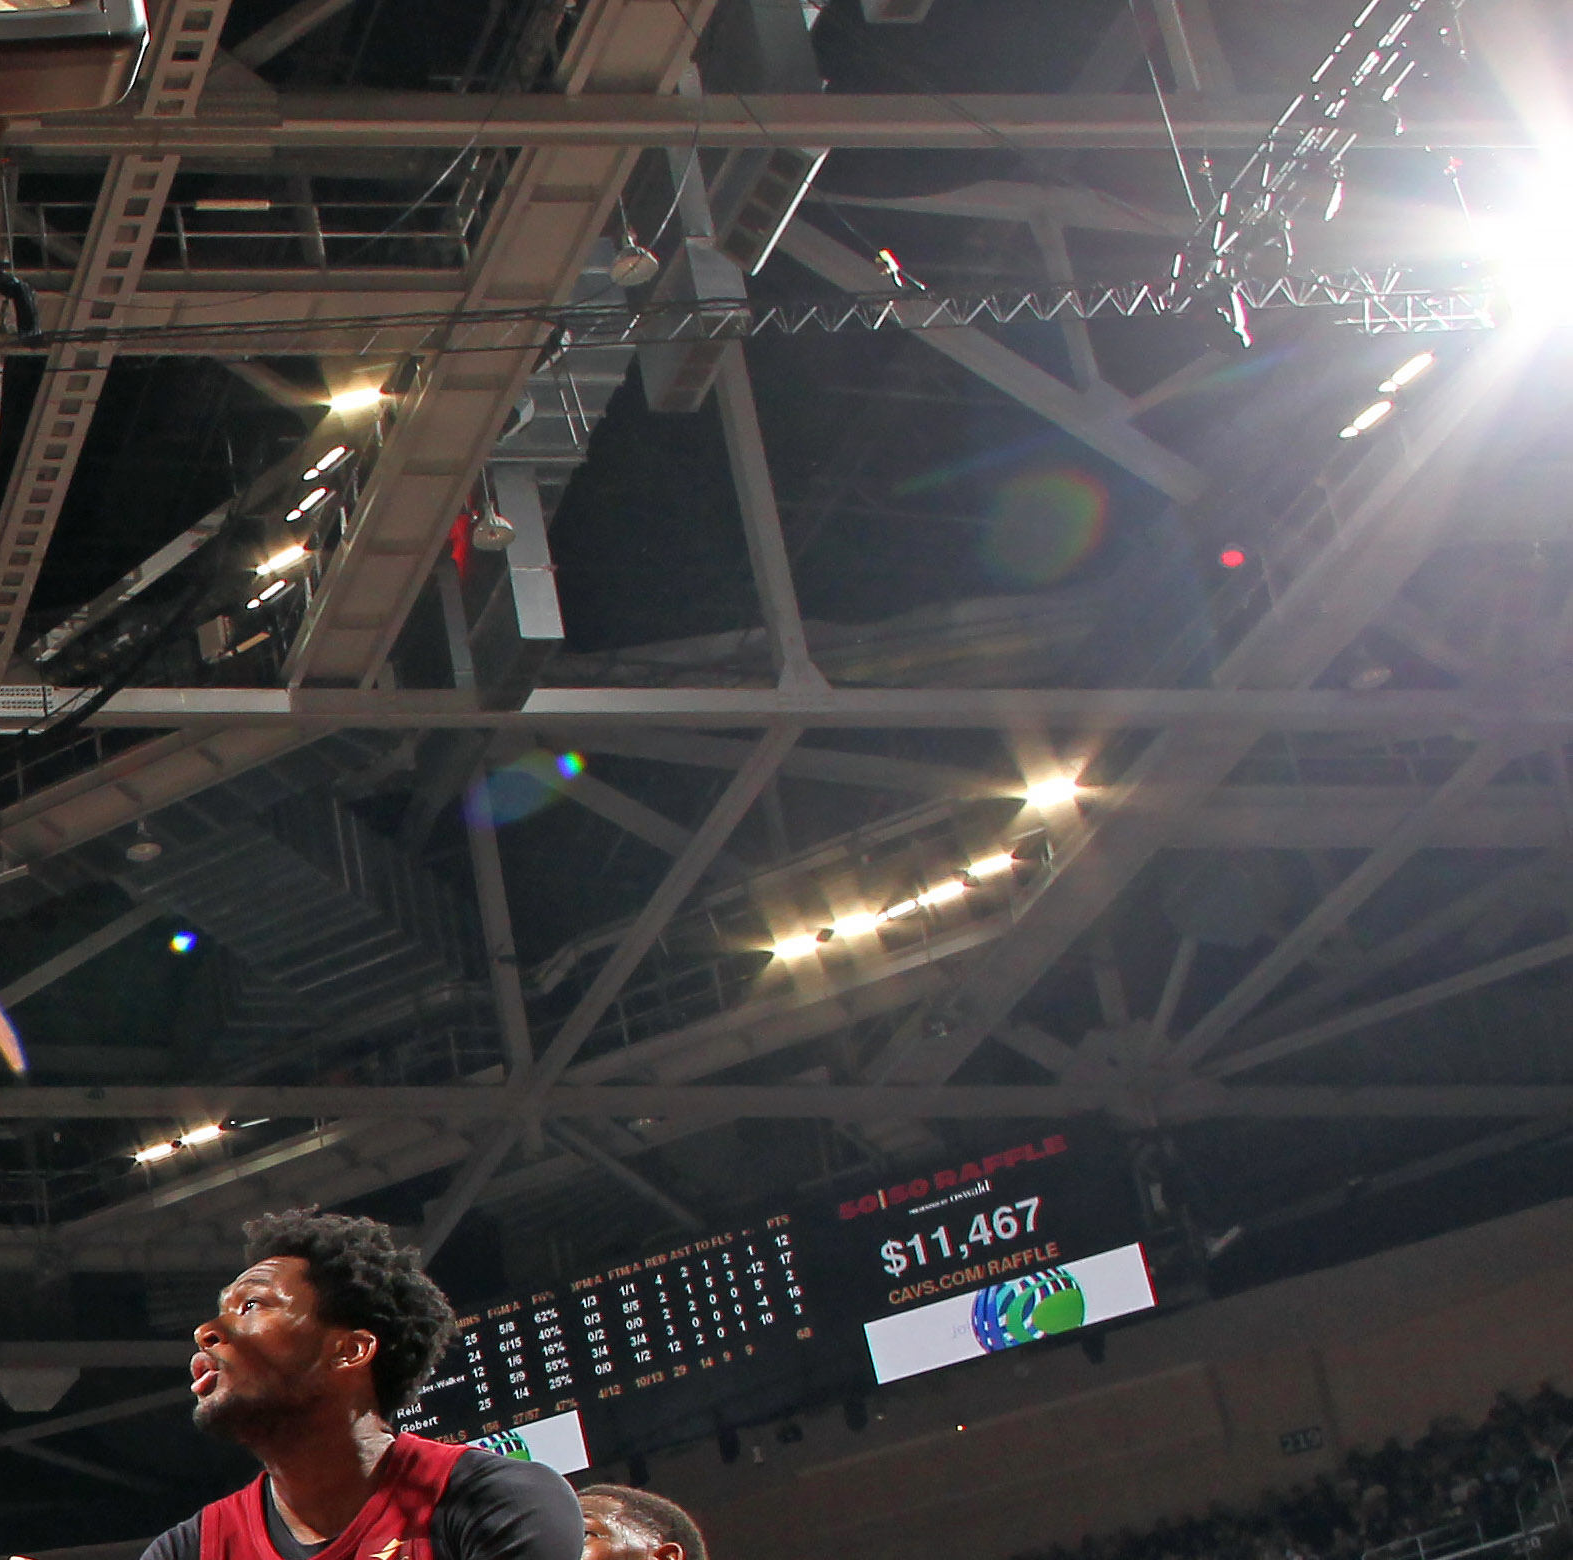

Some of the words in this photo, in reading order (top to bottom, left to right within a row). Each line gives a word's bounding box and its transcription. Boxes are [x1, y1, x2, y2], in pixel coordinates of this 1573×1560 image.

[465, 1333, 477, 1346] 25
[499, 1322, 515, 1334] 5/8
[535, 1309, 557, 1323] 62%
[582, 1296, 596, 1308] 1/3
[620, 1284, 634, 1296] 1/1
[655, 1275, 662, 1284] 4
[681, 1267, 688, 1277] 2
[703, 1260, 708, 1269] 1
[723, 1254, 730, 1264] 2
[748, 1246, 753, 1255] 1
[775, 1235, 788, 1246] 12
[880, 1196, 1042, 1277] $11,467
[889, 1242, 1061, 1305] CAVS.COM/RAFFLE
[397, 1403, 421, 1418] Reid
[476, 1382, 488, 1393] 16
[510, 1371, 525, 1383] 5/9
[546, 1358, 568, 1372] 55%
[592, 1345, 608, 1358] 3/4
[630, 1334, 648, 1346] 3/4
[667, 1325, 673, 1335] 3
[692, 1318, 699, 1327] 0
[714, 1311, 720, 1320] 0
[735, 1304, 741, 1314] 0
[788, 1286, 800, 1298] 16
[468, 1351, 481, 1362] 24
[500, 1337, 521, 1352] 6/15
[539, 1326, 561, 1339] 40%
[584, 1313, 600, 1325] 0/3
[623, 1300, 639, 1313] 5/5
[660, 1292, 666, 1302] 2
[686, 1284, 691, 1293] 1
[706, 1277, 712, 1287] 5
[727, 1271, 733, 1281] 3
[780, 1251, 792, 1264] 17
[473, 1367, 484, 1377] 12
[508, 1355, 522, 1367] 1/6
[543, 1342, 565, 1356] 16%
[588, 1329, 604, 1342] 0/2
[626, 1317, 642, 1330] 0/0
[663, 1309, 670, 1319] 2
[689, 1301, 696, 1311] 2
[710, 1294, 716, 1304] 0
[731, 1288, 737, 1297] 0
[786, 1270, 794, 1281] 2
[400, 1415, 439, 1433] Gobert
[479, 1398, 491, 1410] 25
[514, 1387, 529, 1399] 1/4
[549, 1375, 572, 1389] 25%
[595, 1362, 611, 1375] 0/0
[635, 1351, 651, 1362] 1/2
[668, 1341, 681, 1352] 12
[696, 1334, 704, 1344] 2
[717, 1328, 724, 1337] 0
[740, 1321, 745, 1331] 1
[760, 1313, 772, 1324] 10
[794, 1304, 801, 1314] 3
